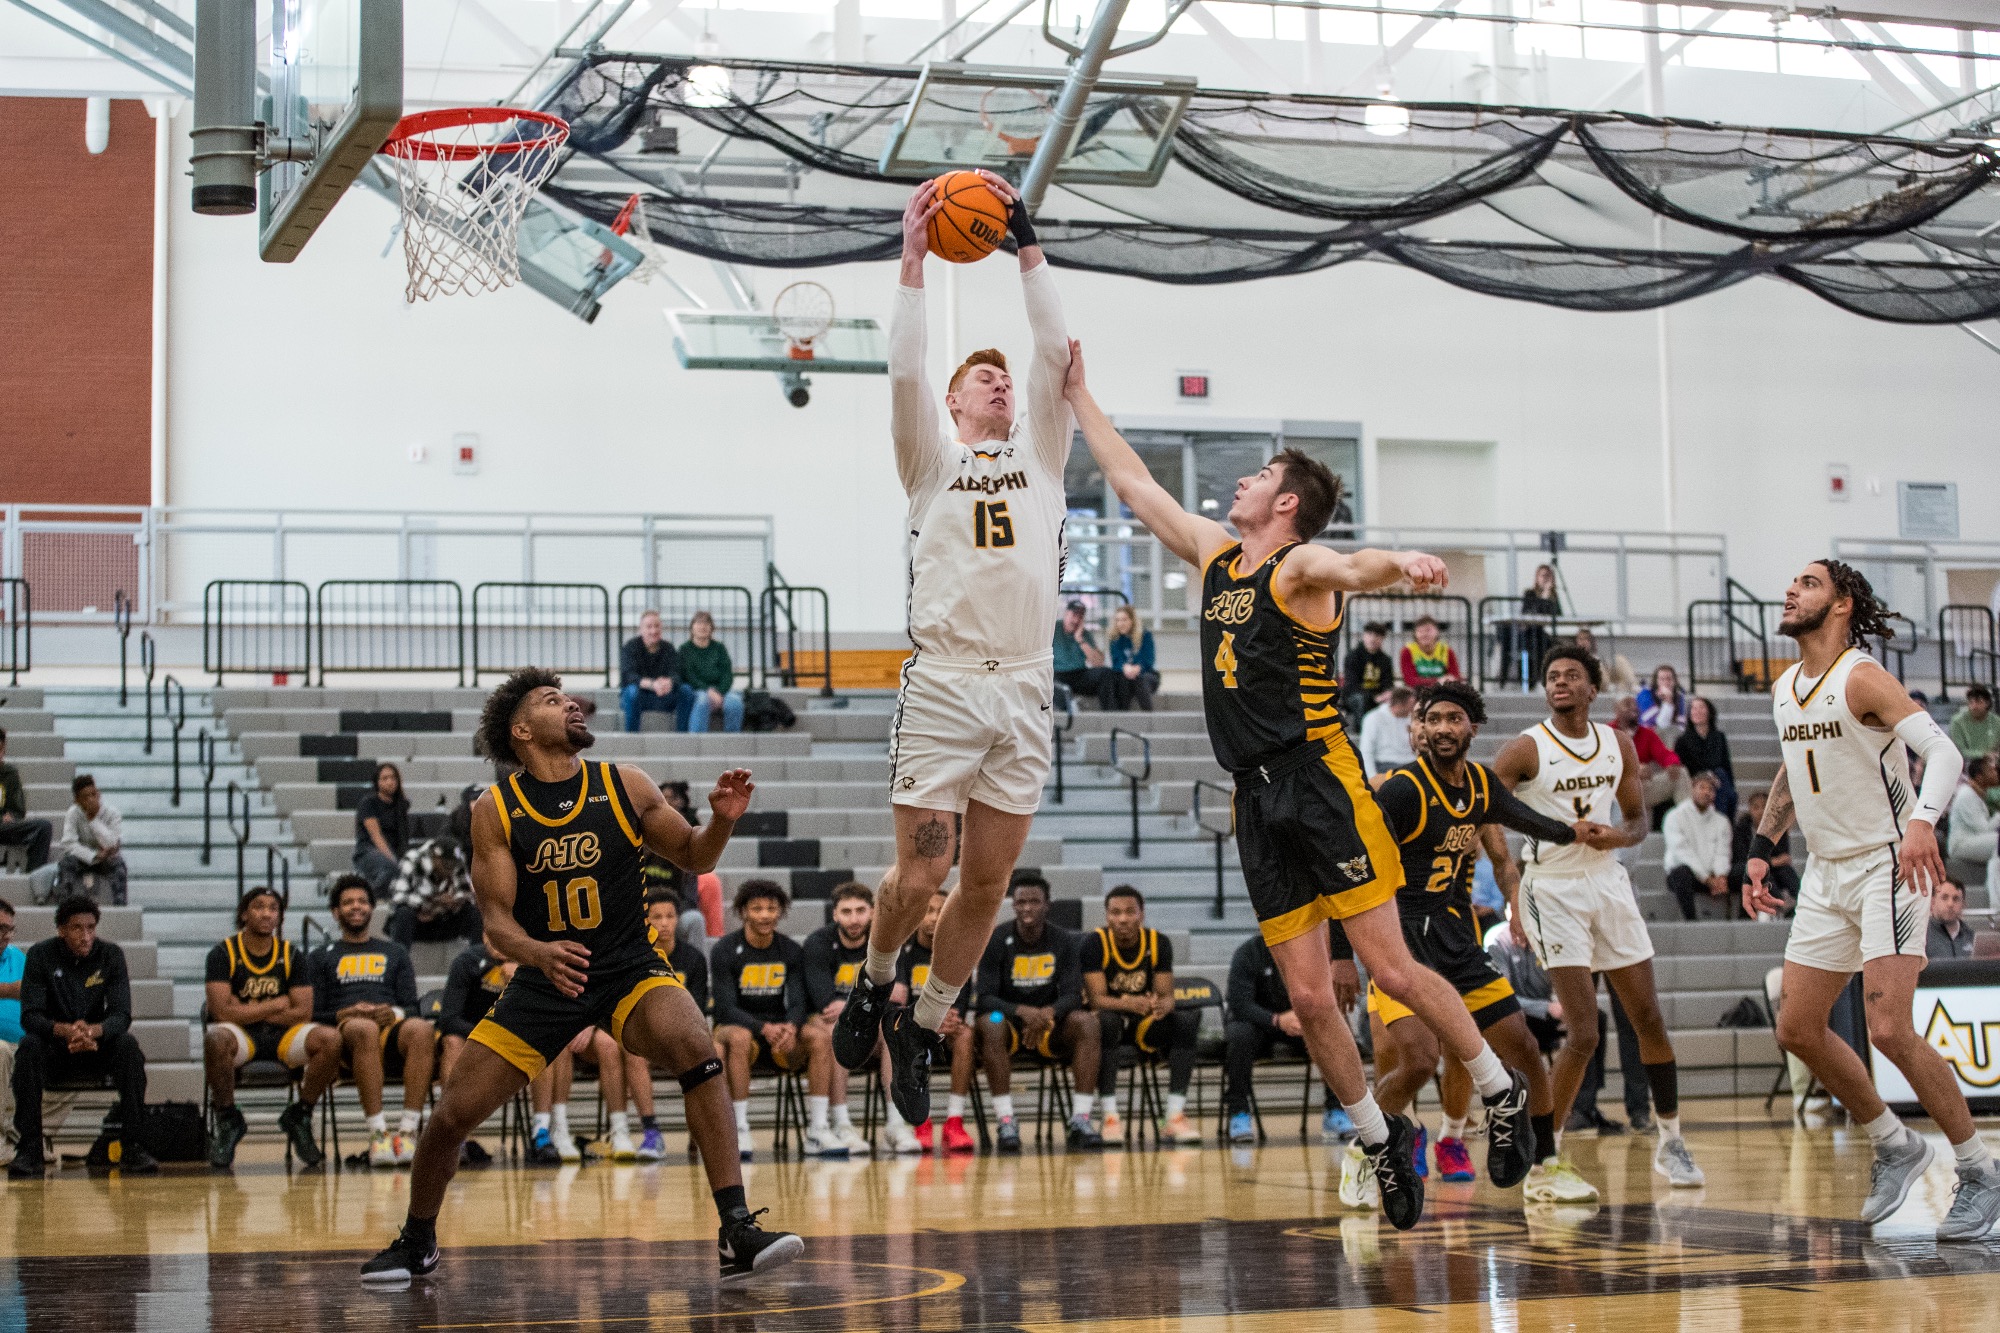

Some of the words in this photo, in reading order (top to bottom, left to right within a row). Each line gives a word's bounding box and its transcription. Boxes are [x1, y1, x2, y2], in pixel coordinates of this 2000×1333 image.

[947, 470, 1028, 494] ADELPHI
[974, 499, 1016, 549] 15
[1213, 630, 1238, 689] 4
[1782, 720, 1843, 742] ADELPHI
[1805, 748, 1821, 795] 1
[525, 831, 602, 874] AIC
[542, 875, 603, 932] 10
[336, 953, 387, 979] AIC
[739, 962, 786, 989] AIC
[1011, 953, 1055, 980] AIC
[1923, 998, 2000, 1088] AU
